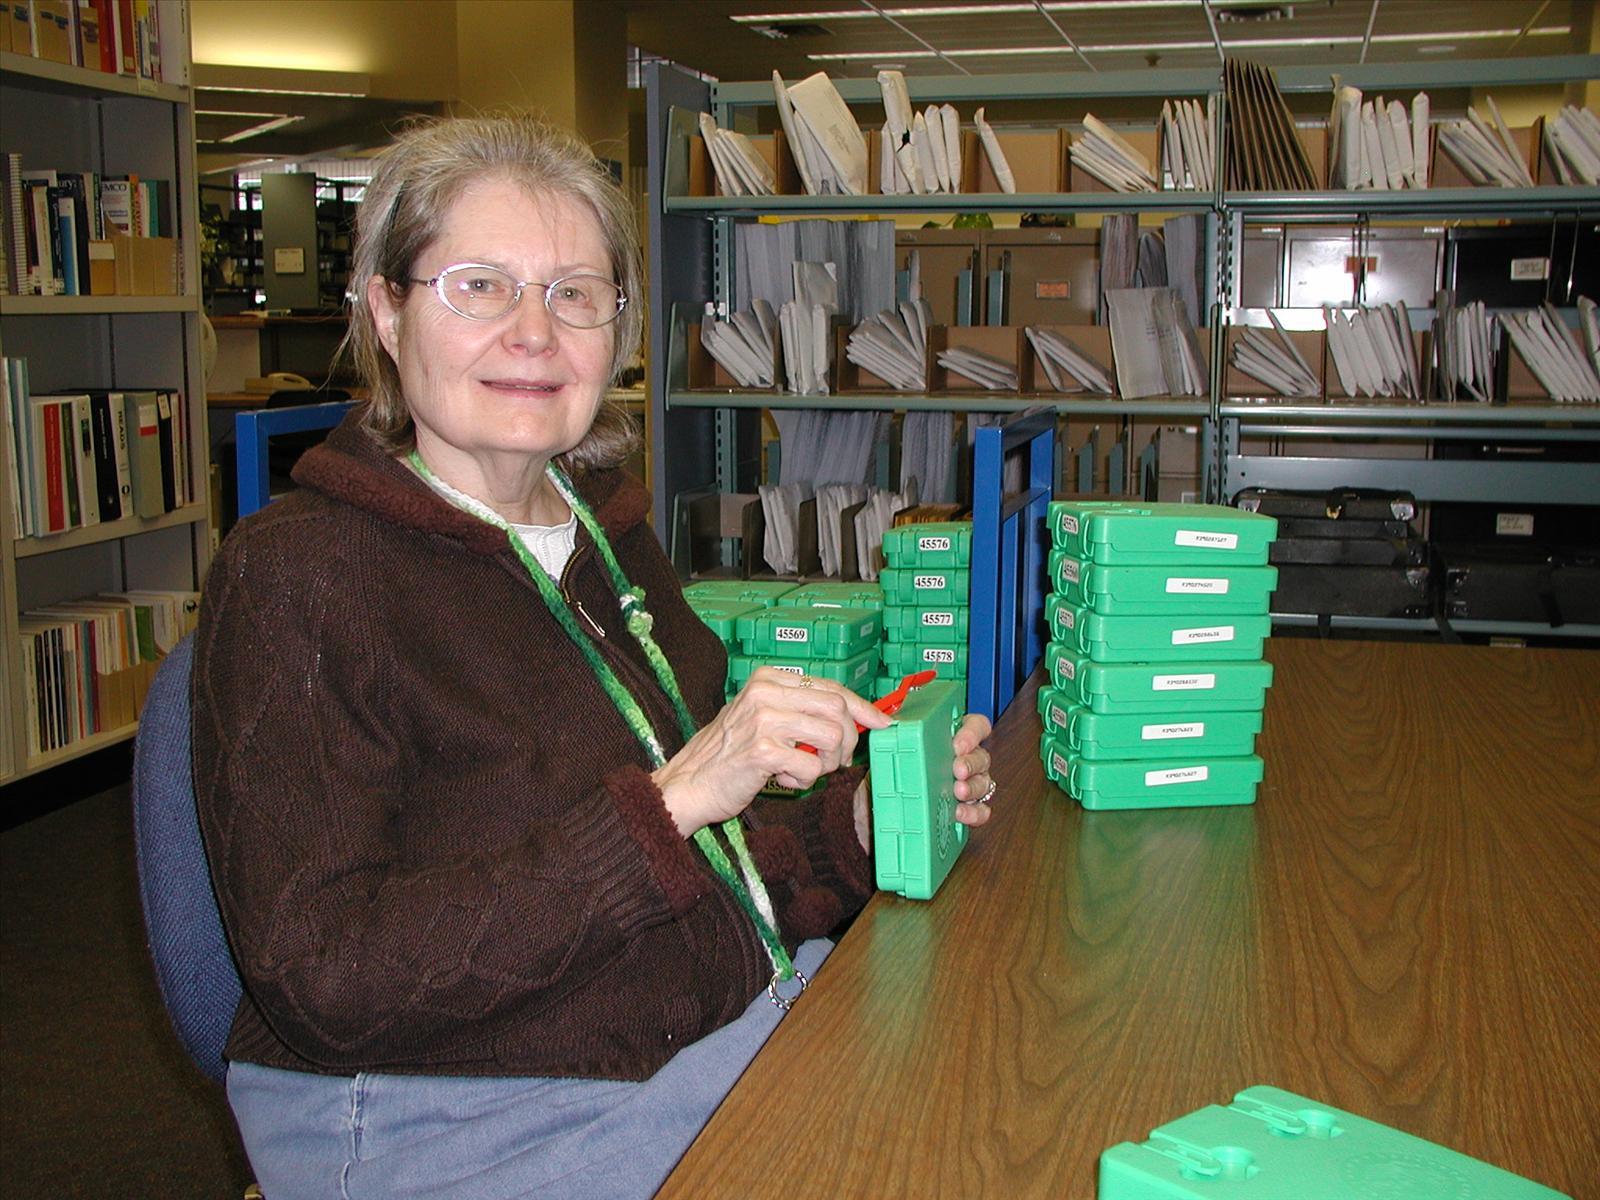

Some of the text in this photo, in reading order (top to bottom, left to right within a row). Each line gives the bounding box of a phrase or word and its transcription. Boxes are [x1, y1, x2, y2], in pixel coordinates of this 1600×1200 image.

[920, 539, 948, 549] 45576
[915, 577, 943, 587] 45576
[923, 614, 951, 624] 45577
[777, 628, 805, 640] 45569
[924, 651, 952, 661] 45578
